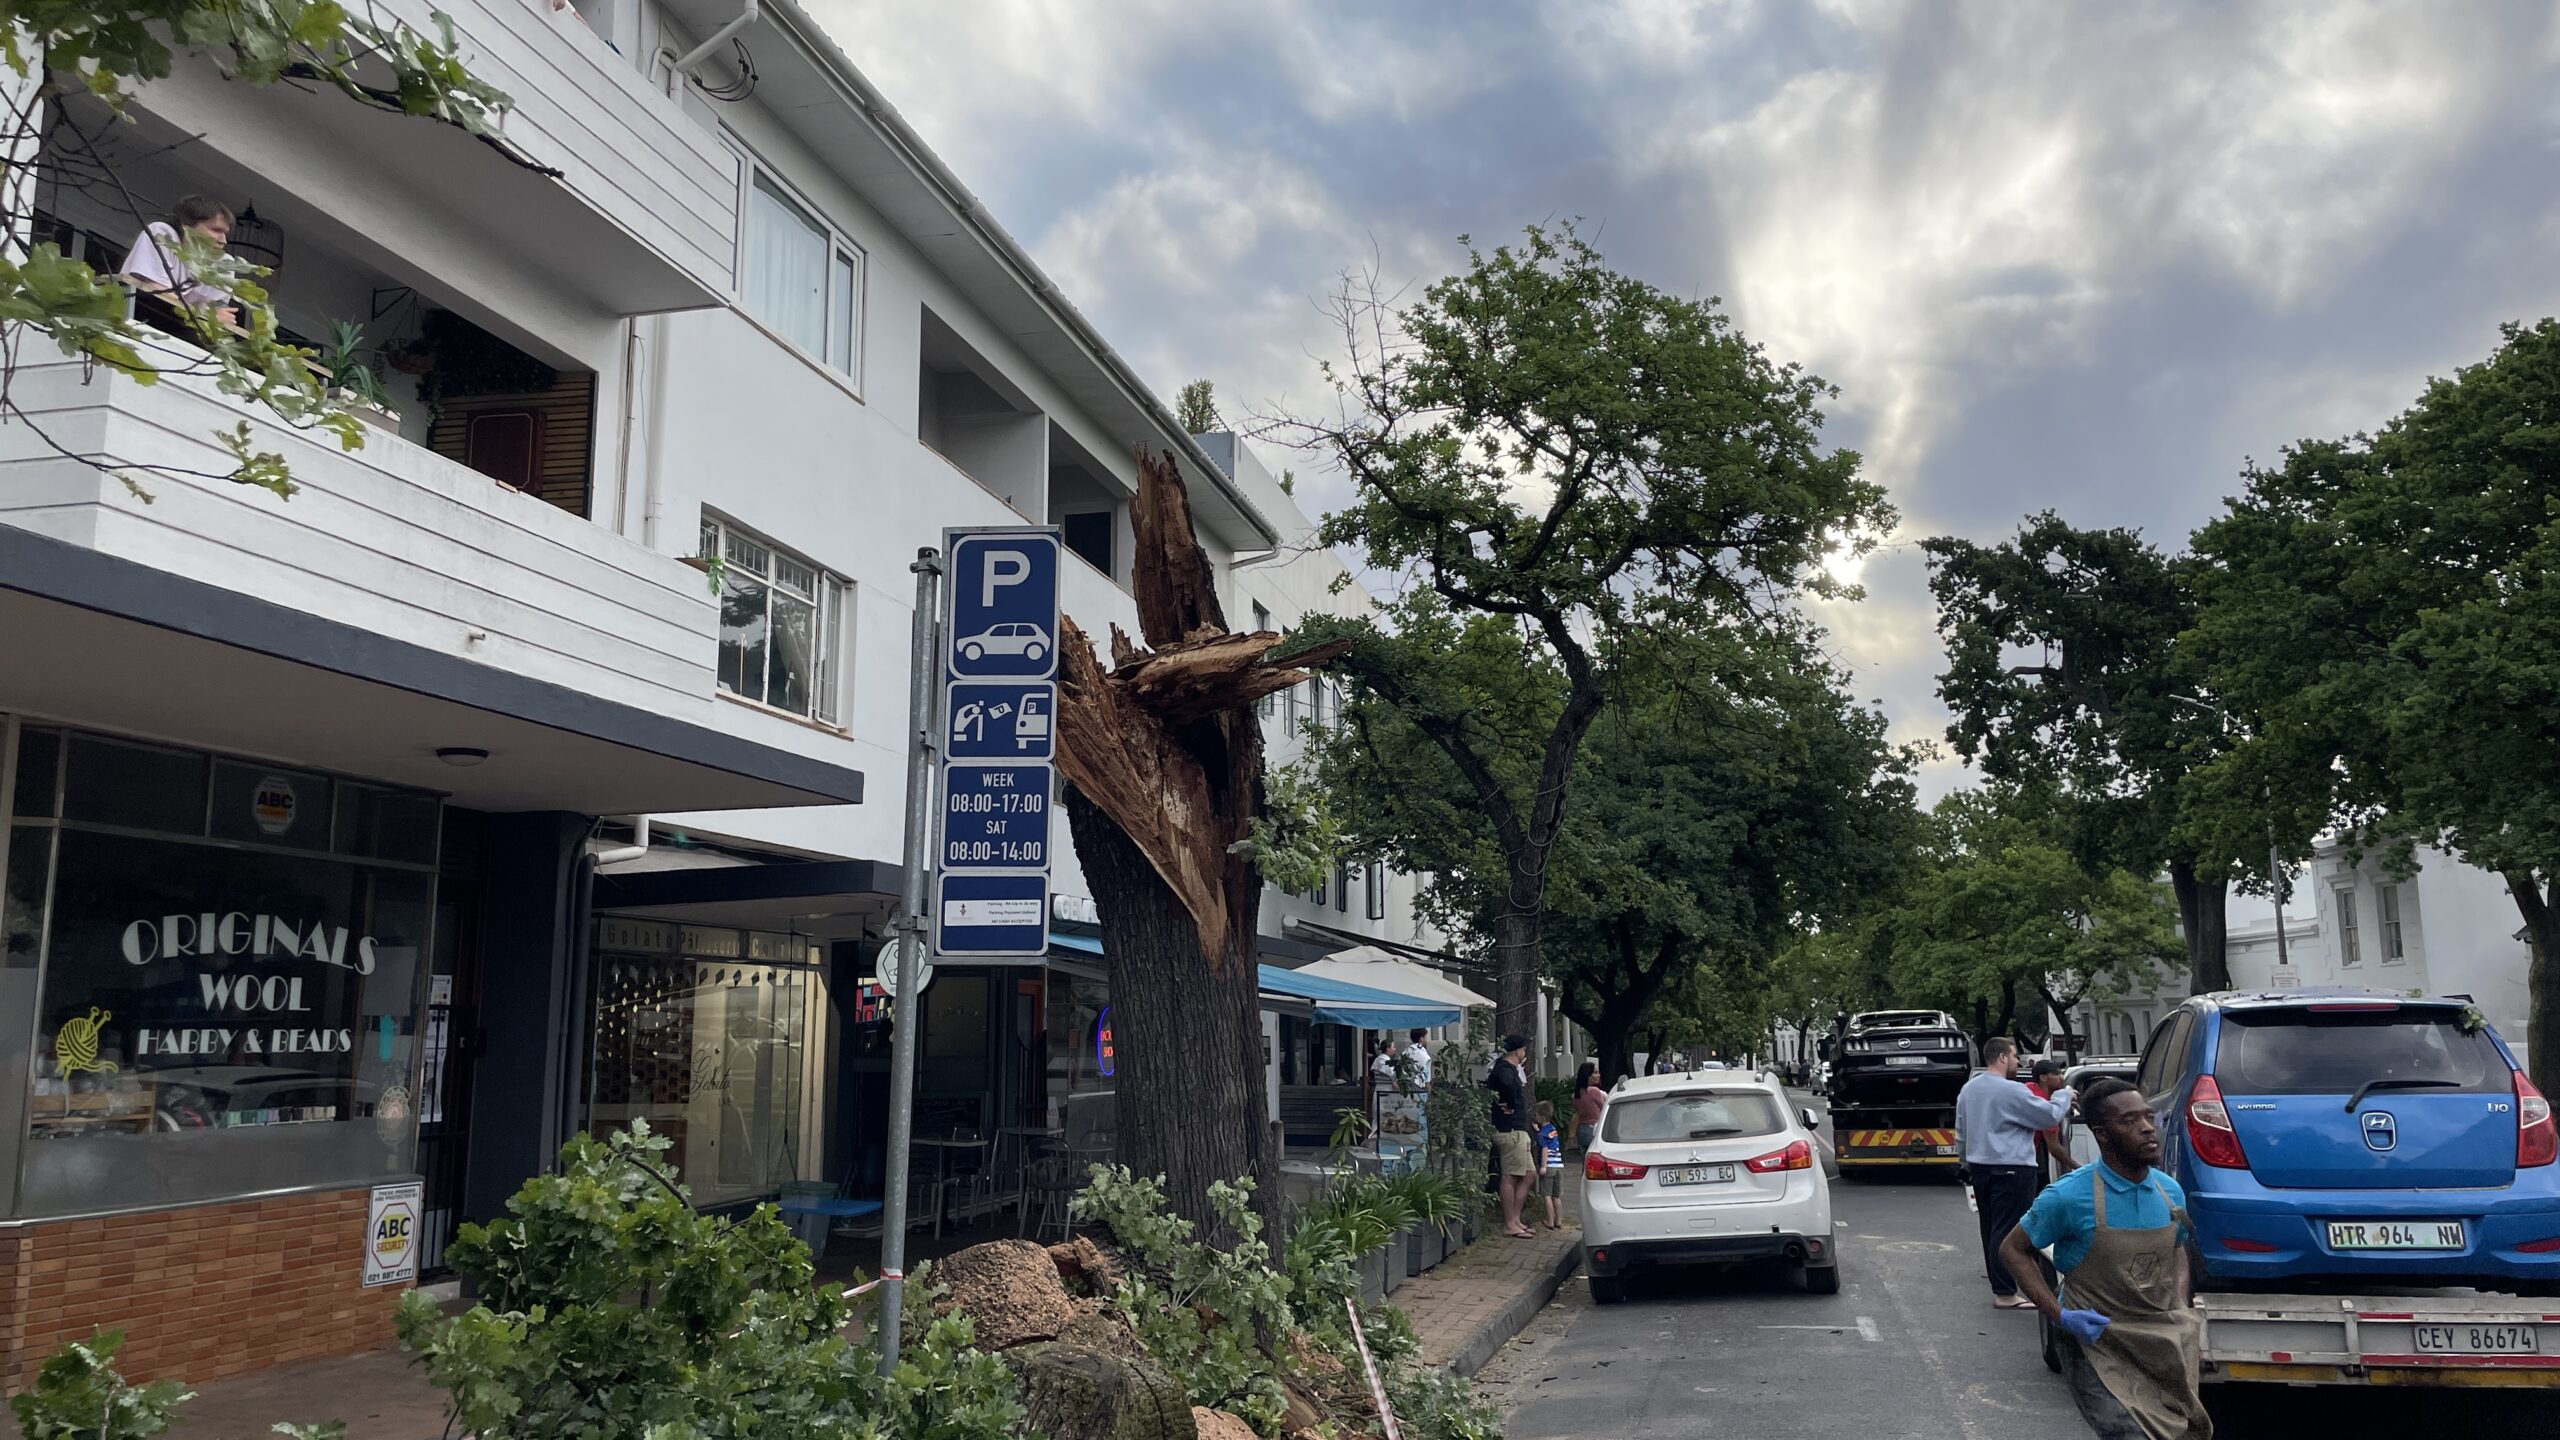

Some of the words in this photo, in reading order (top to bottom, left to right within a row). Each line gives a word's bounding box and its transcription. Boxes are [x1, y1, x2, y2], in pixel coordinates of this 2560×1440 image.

[982, 550, 1031, 607] P
[982, 773, 1015, 787] WEEK
[256, 791, 294, 809] ABC
[951, 793, 1042, 813] 08:00-17:00
[986, 820, 1008, 834] SAT
[950, 841, 1041, 861] 08:00-14:00
[122, 911, 379, 975] ORIGINALS
[607, 924, 673, 948] Gelato
[199, 973, 311, 1012] WOOL
[138, 1028, 239, 1055] HABBY
[244, 1028, 263, 1054] &
[271, 1028, 352, 1053] BEADS
[1688, 1168, 1708, 1181] 593
[1718, 1166, 1732, 1180] EC
[376, 1217, 411, 1240] ABC
[2331, 1225, 2367, 1245] HTR
[2379, 1225, 2415, 1245] 964
[2436, 1225, 2461, 1245] NW
[376, 1239, 410, 1252] SECURITY
[2418, 1327, 2454, 1349] CEY
[2470, 1327, 2532, 1349] 86674
